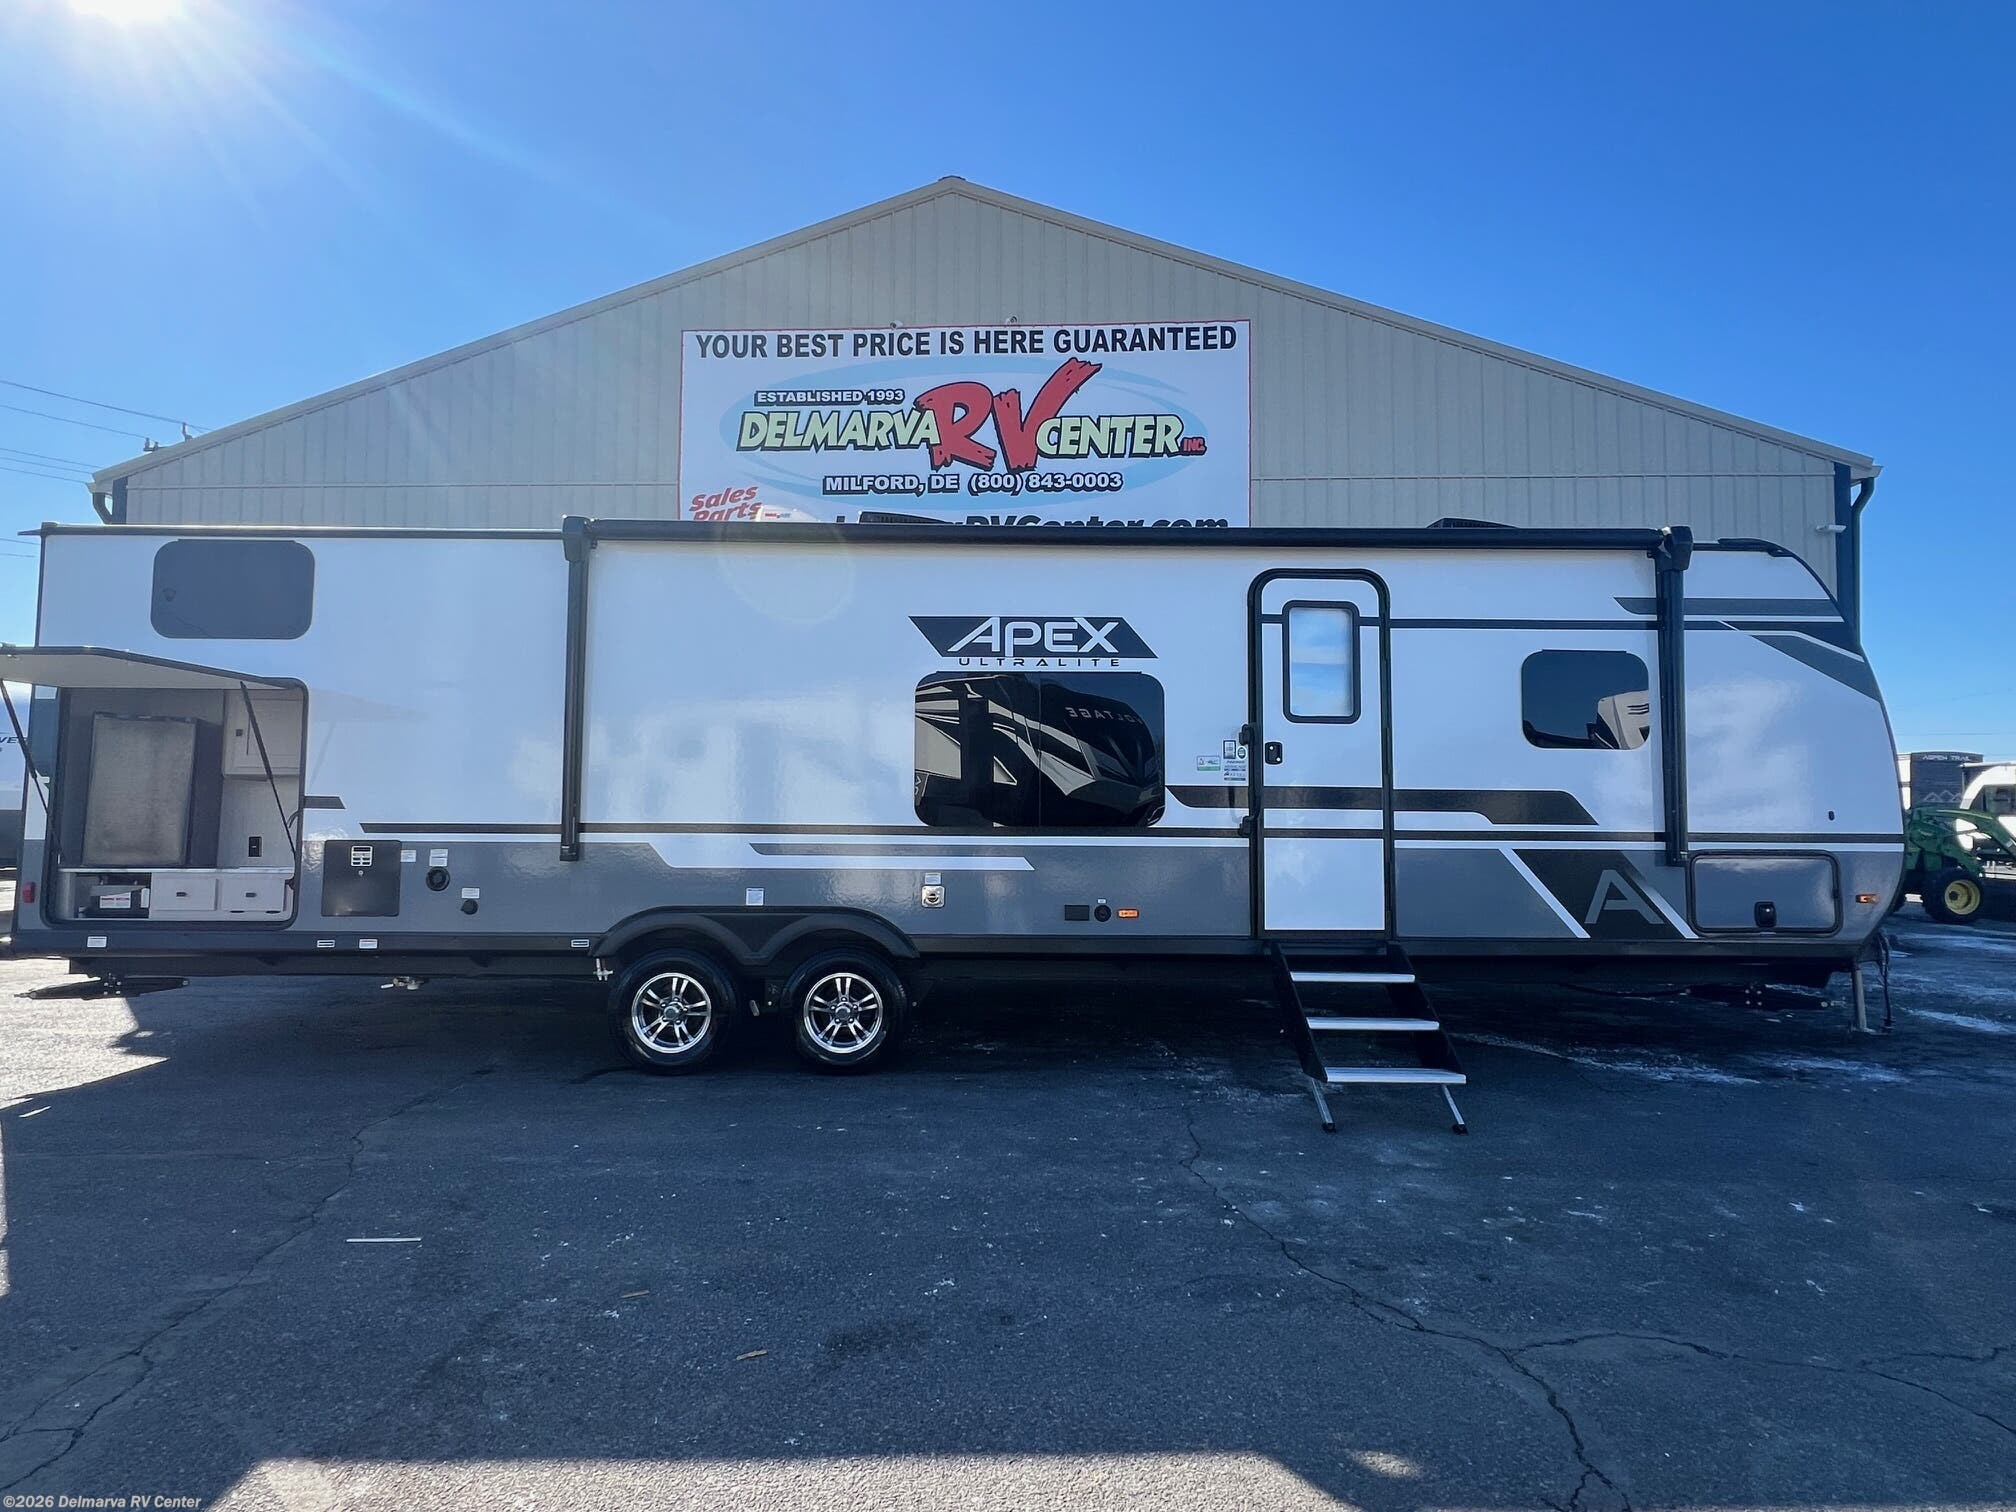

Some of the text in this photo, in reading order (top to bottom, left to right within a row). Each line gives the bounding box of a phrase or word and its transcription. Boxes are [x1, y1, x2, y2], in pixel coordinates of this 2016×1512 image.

[696, 326, 1237, 359] YOUR BEST PRICE IS HERE GUARANTEED
[755, 388, 905, 405] ESTABLISHED 1993
[738, 410, 940, 452] DELMARVA
[913, 357, 1102, 472] RV
[1035, 414, 1184, 458] CENTER
[823, 472, 1123, 496] MILFORD, DE (800) 843-0003
[689, 486, 758, 511] Sales
[948, 616, 1119, 656] APEX
[958, 658, 1120, 667] ULTRALITE
